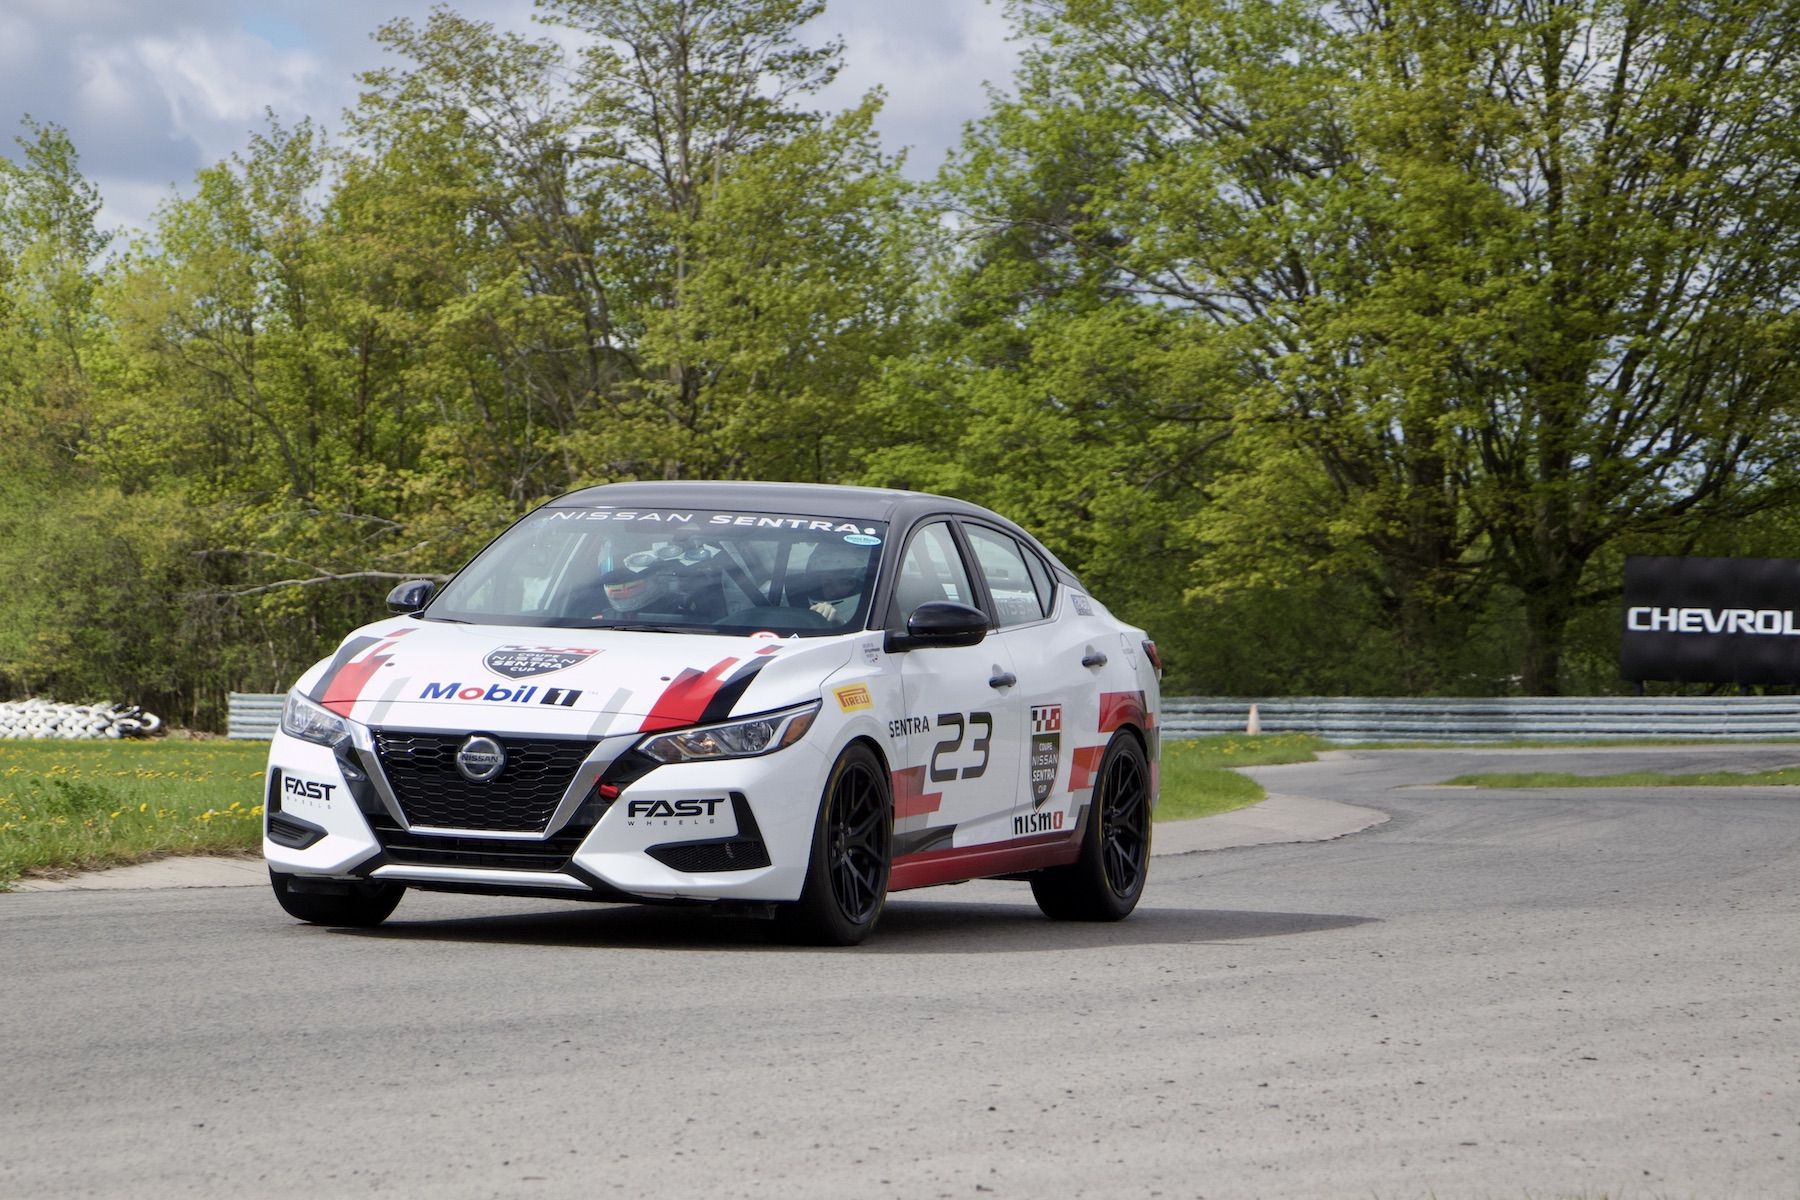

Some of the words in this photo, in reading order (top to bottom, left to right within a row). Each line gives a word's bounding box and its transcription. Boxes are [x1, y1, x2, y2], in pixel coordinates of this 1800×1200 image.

[549, 511, 694, 522] NISSAN
[709, 515, 861, 534] SENTRA
[1627, 606, 1800, 635] CHEVROL
[491, 655, 576, 664] NISSAN
[491, 661, 562, 669] SENTRA
[419, 682, 539, 703] Mobil
[836, 687, 870, 708] PIRELLI
[888, 715, 930, 738] SENTRA
[930, 711, 993, 783] 23
[460, 753, 499, 763] NISSAN
[1031, 754, 1058, 766] NISSAN
[1032, 768, 1056, 782] SENTRA
[285, 776, 337, 801] FAST
[1037, 784, 1047, 794] CUP
[628, 798, 726, 818] FAST
[627, 818, 715, 827] WHEELS
